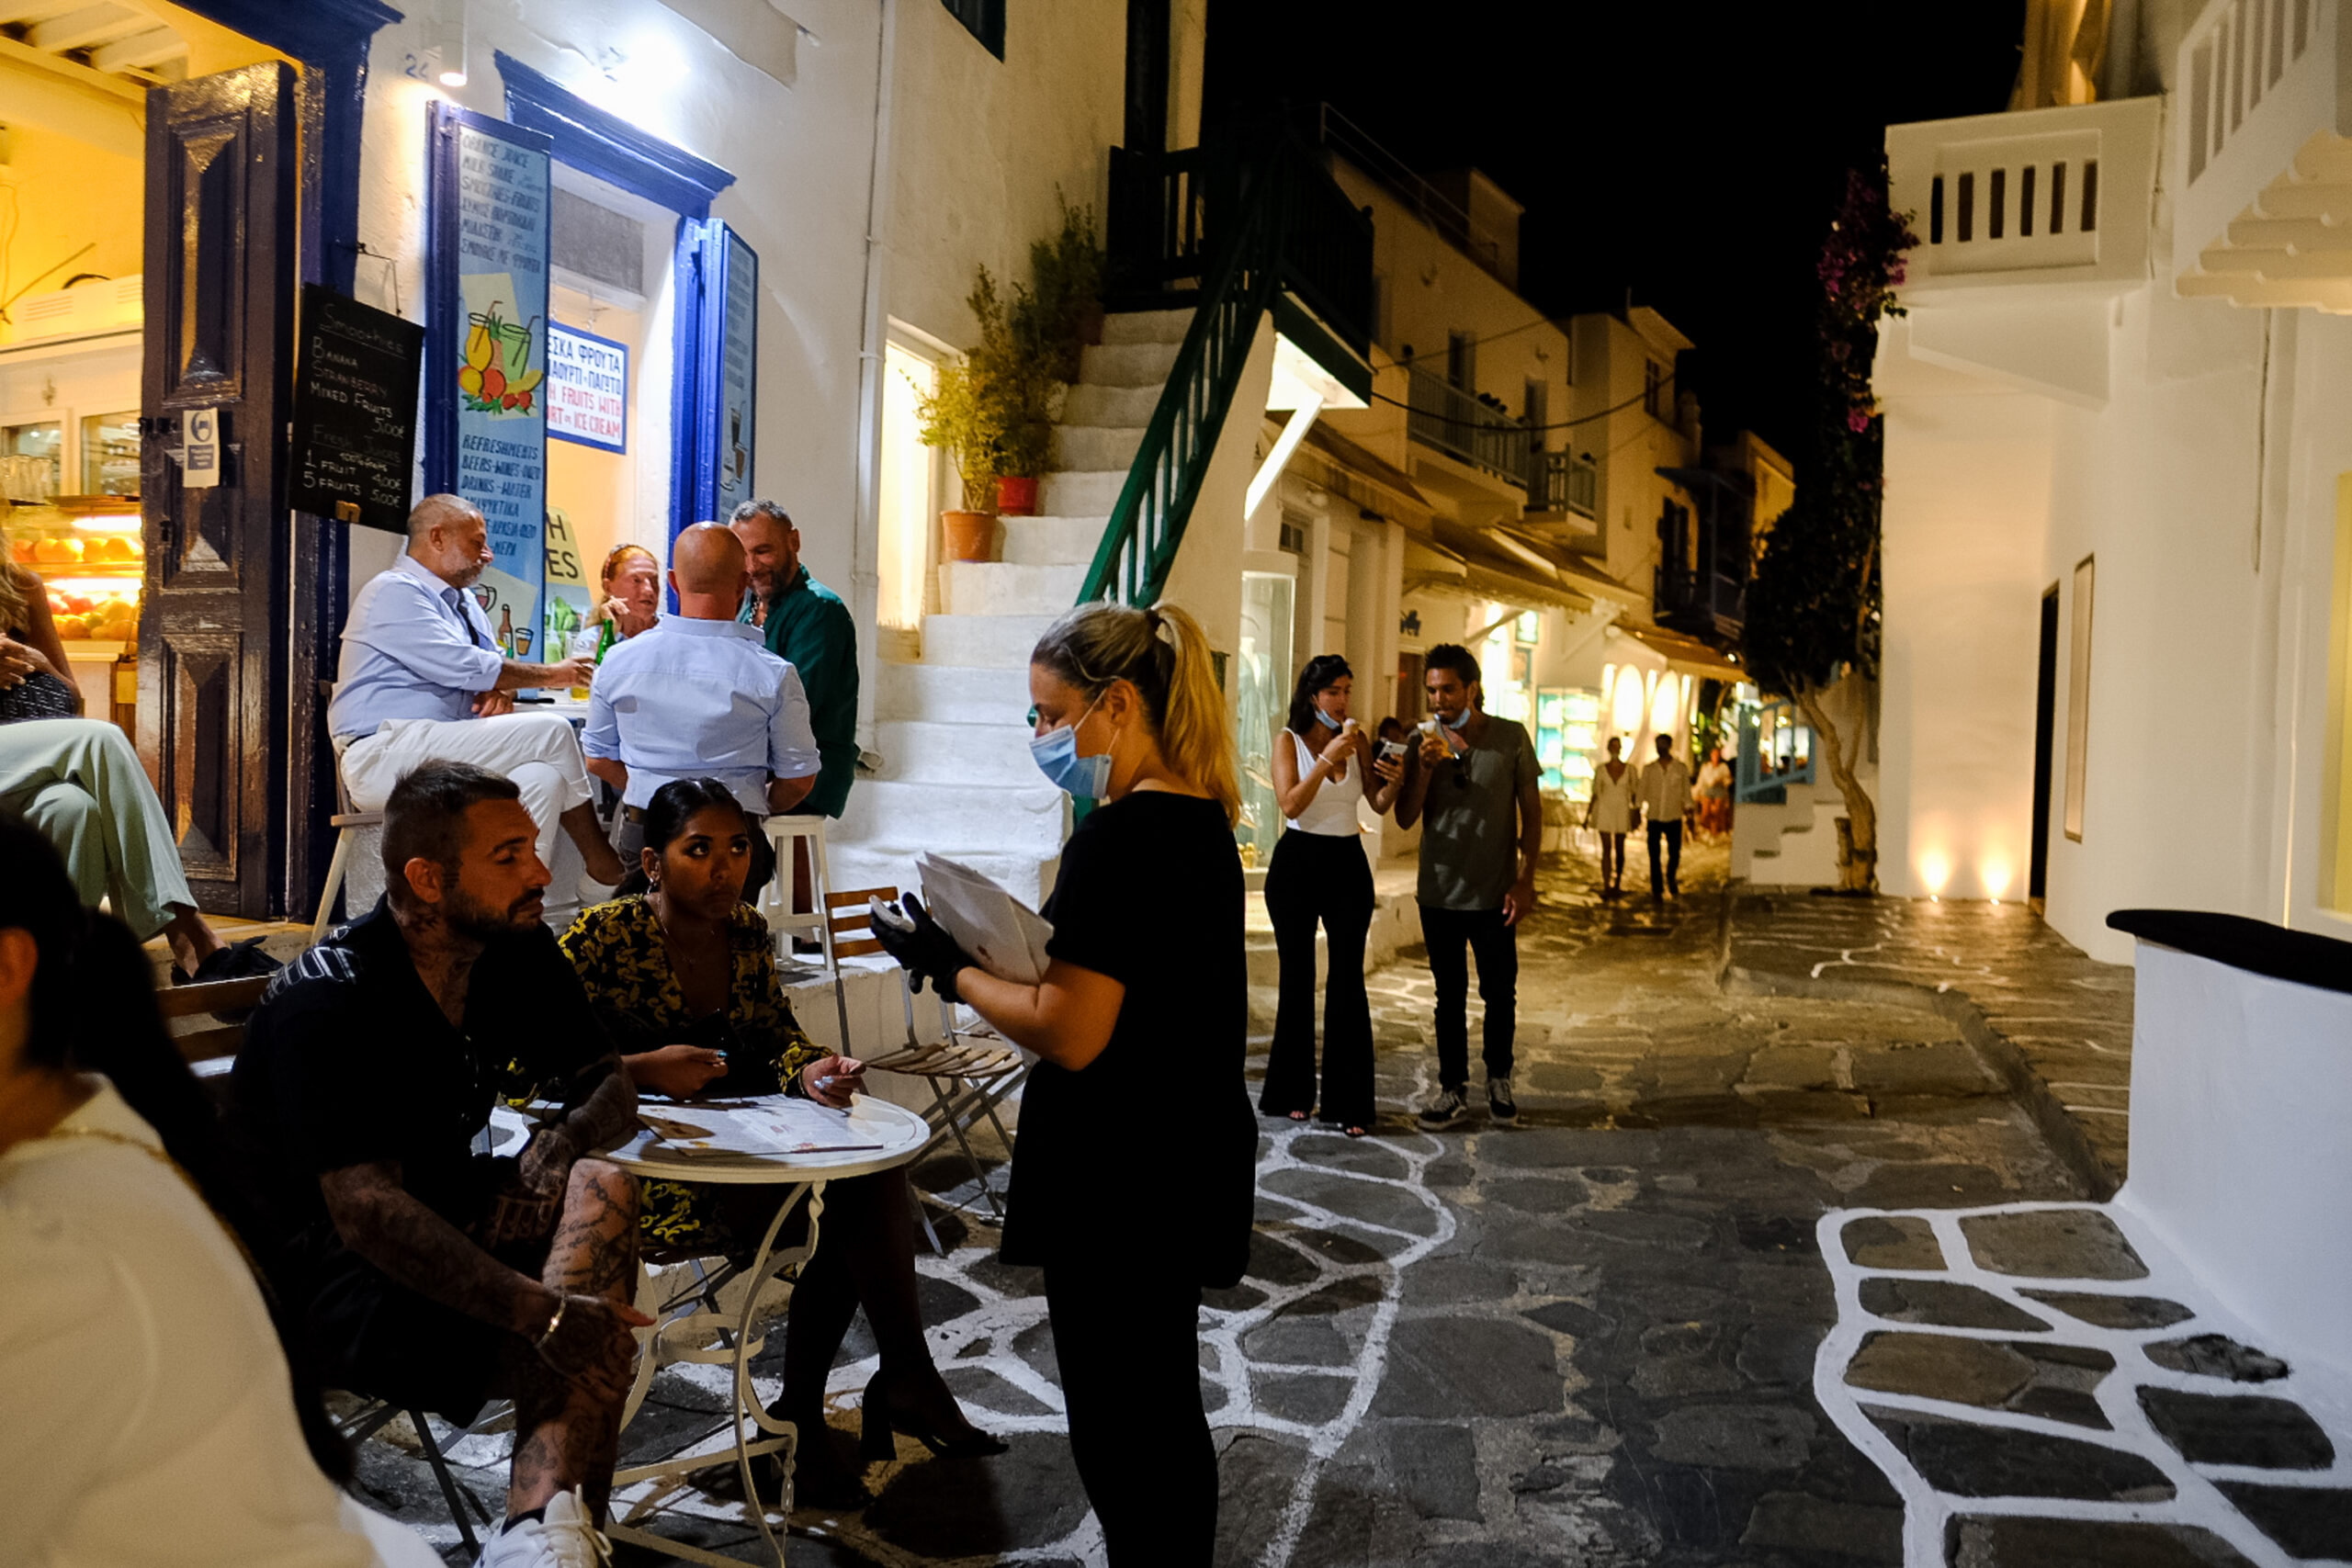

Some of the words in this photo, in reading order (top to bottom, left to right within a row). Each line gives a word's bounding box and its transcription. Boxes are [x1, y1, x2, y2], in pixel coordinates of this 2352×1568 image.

[579, 344, 621, 374] ΦΡΟΥΤΑ
[310, 381, 348, 404] MIXED
[562, 386, 594, 411] FRUITS
[599, 395, 622, 417] WITH
[574, 412, 587, 432] ICE
[589, 414, 621, 439] CREAM
[462, 434, 539, 460] REFRESHMENTS
[321, 459, 356, 476] FRUIT
[319, 478, 361, 497] FRUITS
